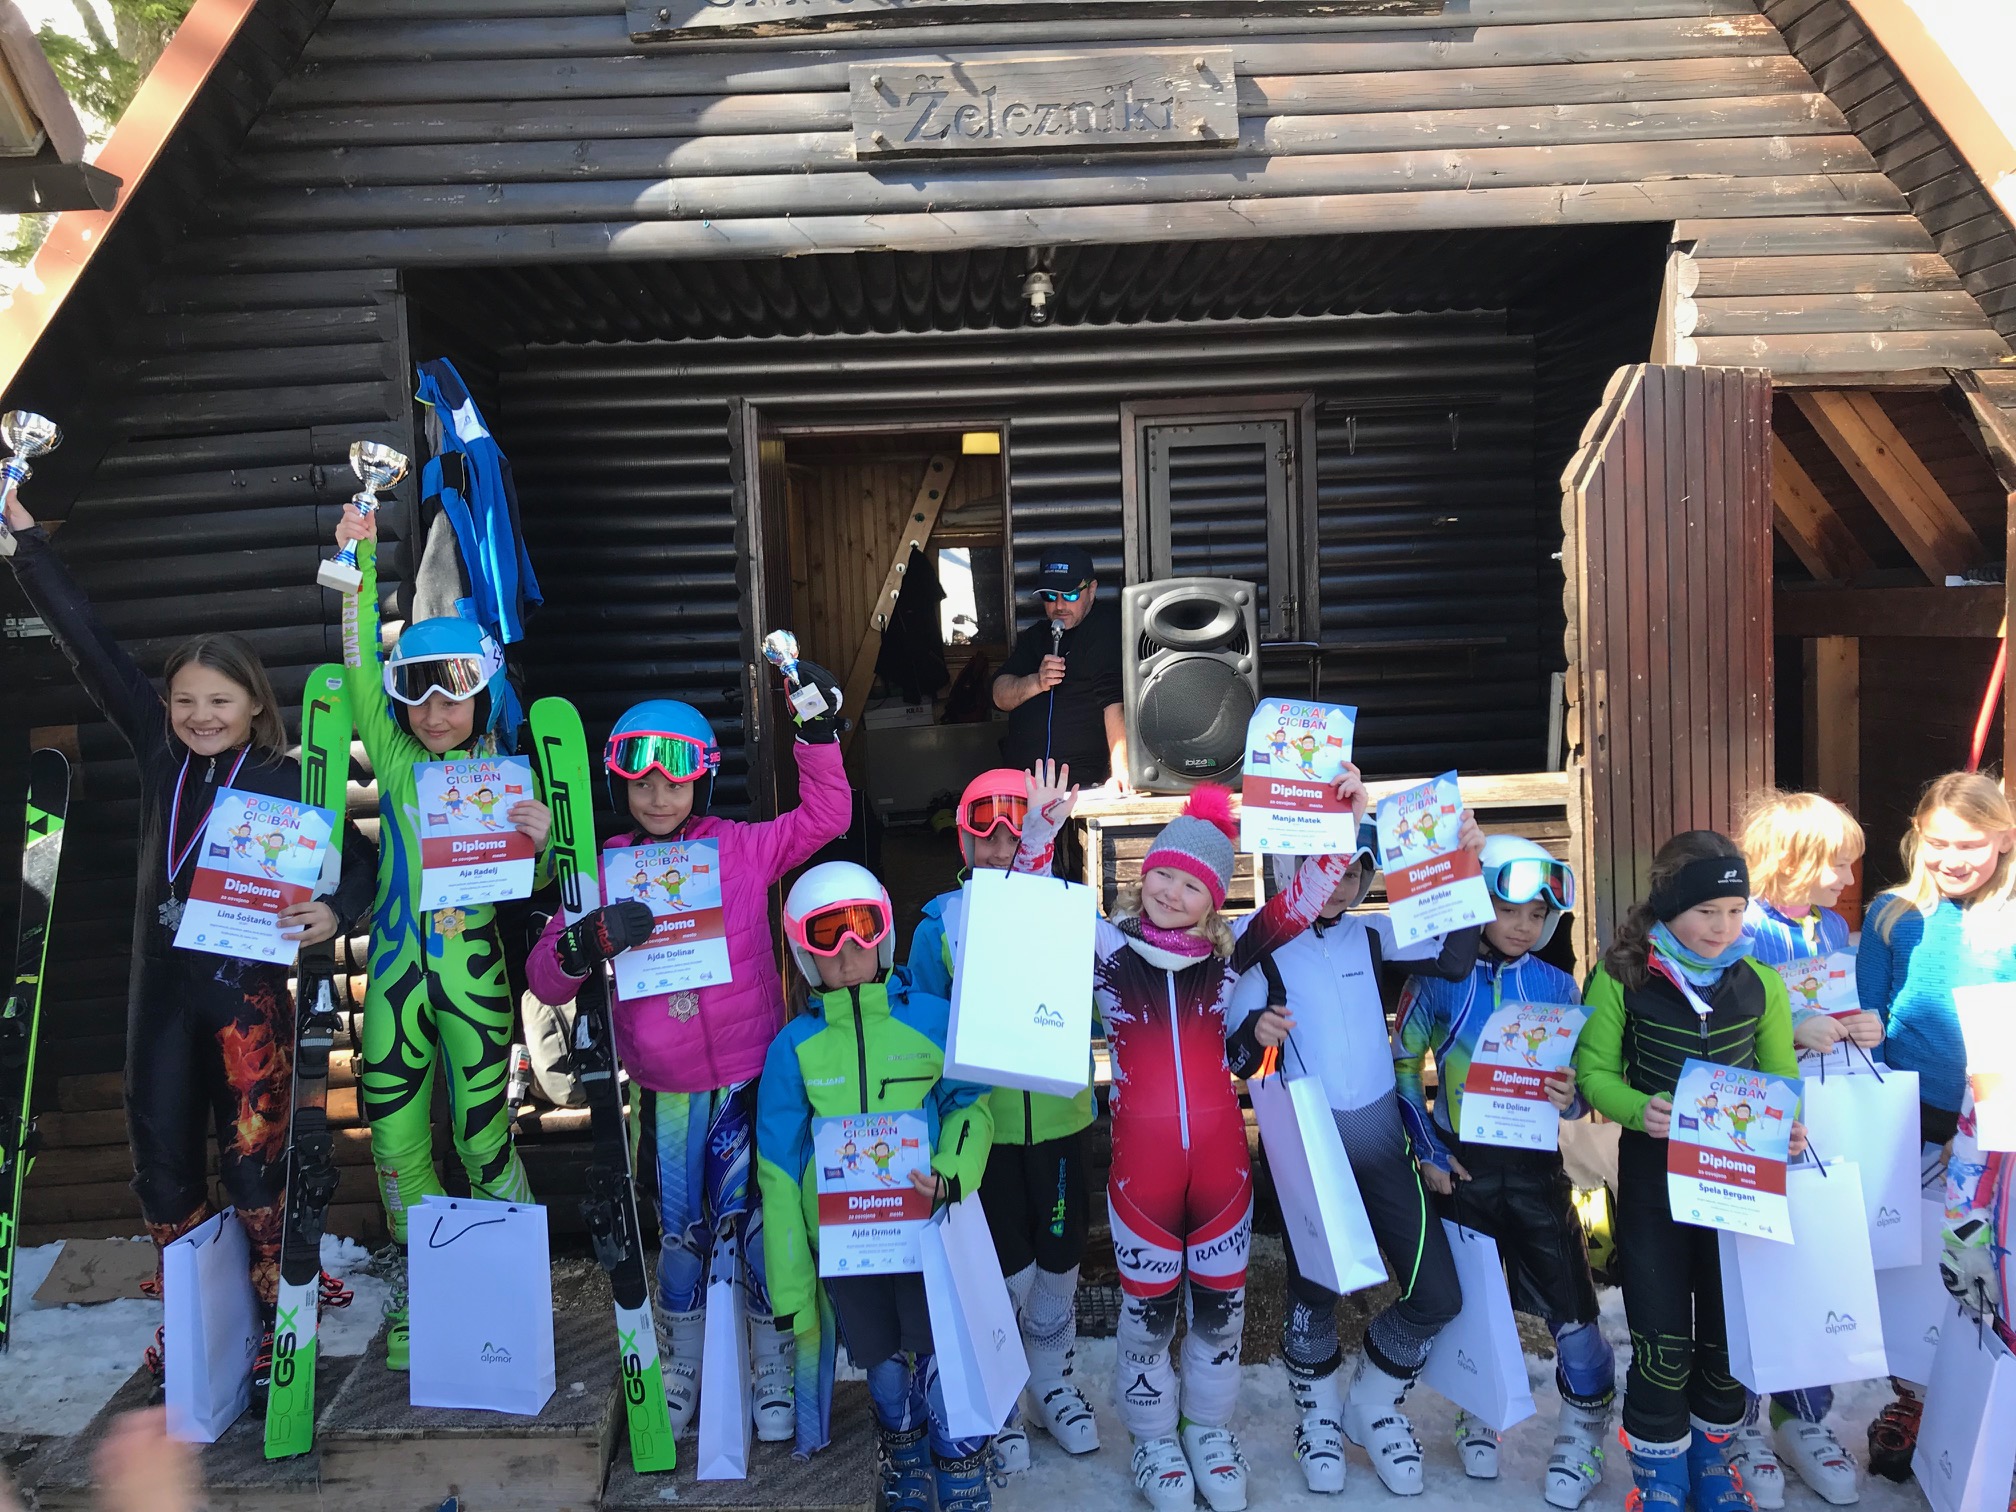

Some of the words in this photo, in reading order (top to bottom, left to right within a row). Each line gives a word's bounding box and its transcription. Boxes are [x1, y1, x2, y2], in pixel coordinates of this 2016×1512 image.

[904, 73, 1179, 142] Železniki
[342, 592, 361, 668] TREME
[1280, 703, 1328, 720] POKAL
[1278, 716, 1327, 730] CICIBAN
[444, 762, 499, 775] POKAL
[446, 773, 501, 785] CICIBAN
[1270, 783, 1323, 799] Diploma
[1398, 784, 1437, 806] POKAL
[246, 797, 302, 819] POKAL
[1398, 794, 1438, 816] CICIBAN
[243, 810, 300, 830] CICIBAN
[1272, 814, 1296, 823] Manja
[1297, 816, 1321, 824] Matek
[452, 840, 506, 853] Diploma
[634, 846, 689, 859] POKAL
[635, 855, 689, 868] CICIBAN
[459, 869, 472, 878] Aja
[474, 866, 498, 876] Radelj
[1409, 860, 1451, 883] Diploma
[224, 878, 281, 898] Diploma
[1418, 897, 1431, 906] Ana
[217, 910, 235, 920] Lina
[236, 912, 272, 927] Šoštarko
[652, 917, 695, 934] ploma
[647, 953, 665, 962] Ajda
[667, 948, 695, 958] Dolinar
[1522, 1005, 1567, 1016] POKAL
[1034, 1015, 1065, 1028] alpmor
[1516, 1013, 1563, 1024] CICIBAN
[1493, 1070, 1540, 1087] Diploma
[1713, 1069, 1768, 1089] POKAL
[1710, 1081, 1767, 1100] CICIBAN
[1492, 1101, 1505, 1110] Eva
[1506, 1103, 1531, 1113] Dolinar
[842, 1116, 897, 1129] POKAL
[844, 1127, 898, 1138] CICIBAN
[1699, 1151, 1756, 1174] Diploma
[1698, 1183, 1721, 1196] Špela
[1723, 1188, 1756, 1202] Bergant
[848, 1195, 903, 1211] Diploma
[851, 1229, 870, 1238] Ajda
[871, 1228, 901, 1237] Drmota
[661, 1314, 701, 1322] HEAD
[1826, 1323, 1857, 1335] alpmor
[481, 1354, 512, 1364] alpmor
